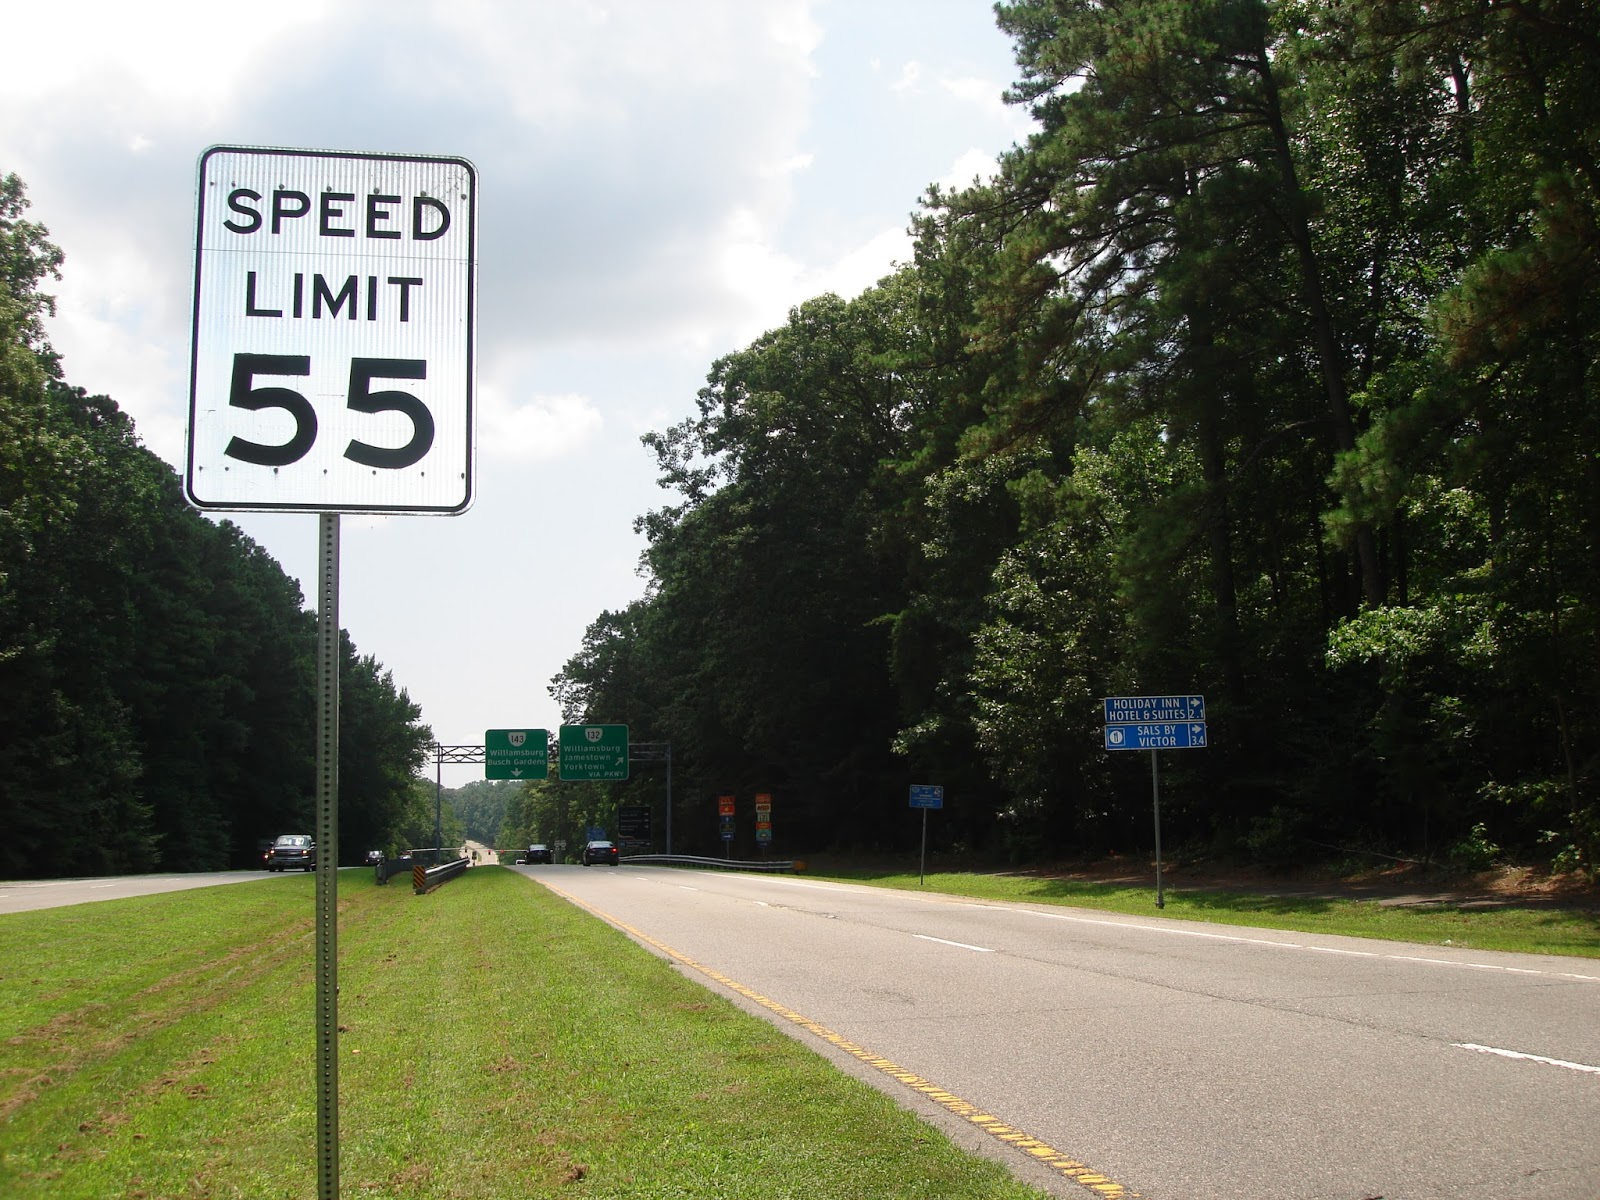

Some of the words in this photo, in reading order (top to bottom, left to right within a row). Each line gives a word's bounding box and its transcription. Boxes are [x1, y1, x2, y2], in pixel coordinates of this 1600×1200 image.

[223, 188, 451, 241] SPEED
[246, 271, 423, 322] LIMIT
[224, 353, 435, 469] 55
[1113, 698, 1157, 709] HOLIDAY
[1161, 698, 1180, 708] INN
[1109, 710, 1141, 721] HOTEL
[1143, 711, 1150, 720] &
[1152, 709, 1186, 719] SUITES
[1189, 709, 1204, 719] 2.1
[587, 731, 600, 739] 132
[1137, 725, 1160, 736] SALS
[1164, 724, 1177, 735] BY
[511, 735, 524, 743] 143
[1138, 736, 1177, 747] VICTOR
[1191, 735, 1205, 746] 3.4
[490, 749, 544, 757] Williamsburg
[563, 745, 620, 753] Williamsburg
[513, 758, 546, 766] Gardens
